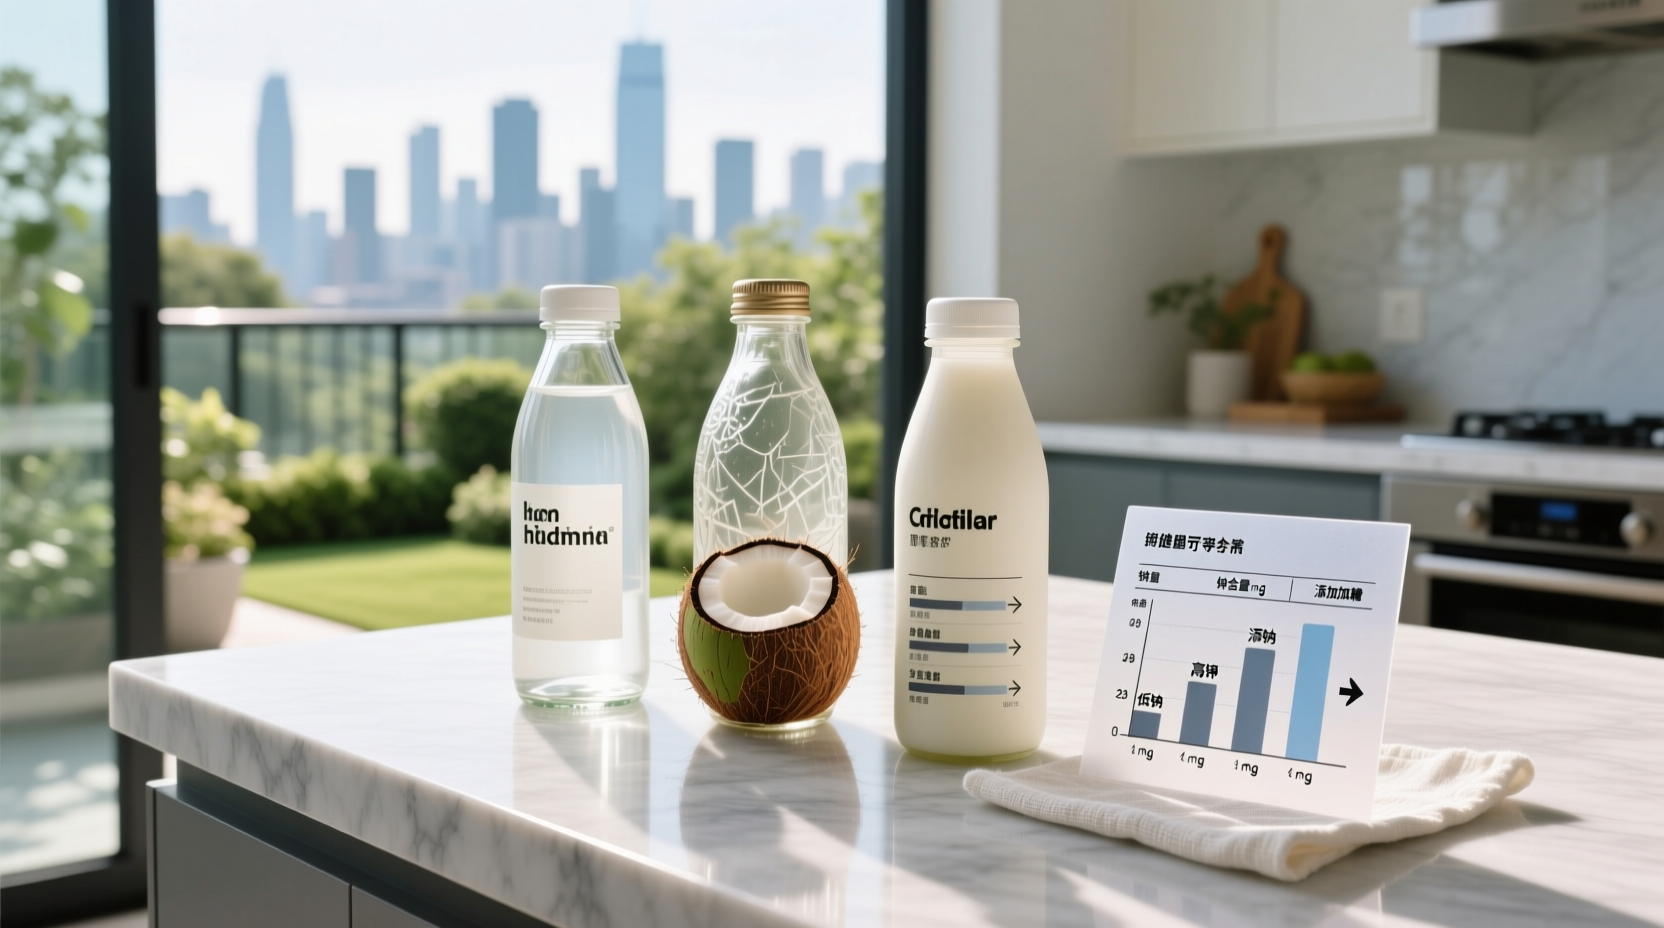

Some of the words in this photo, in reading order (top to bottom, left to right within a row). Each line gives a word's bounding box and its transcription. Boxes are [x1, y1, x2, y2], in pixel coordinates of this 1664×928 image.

[1115, 688, 1129, 700] 23
[1111, 726, 1119, 737] 0
[1137, 747, 1154, 761] mg
[1187, 755, 1205, 769] mg
[1241, 763, 1259, 777] mg
